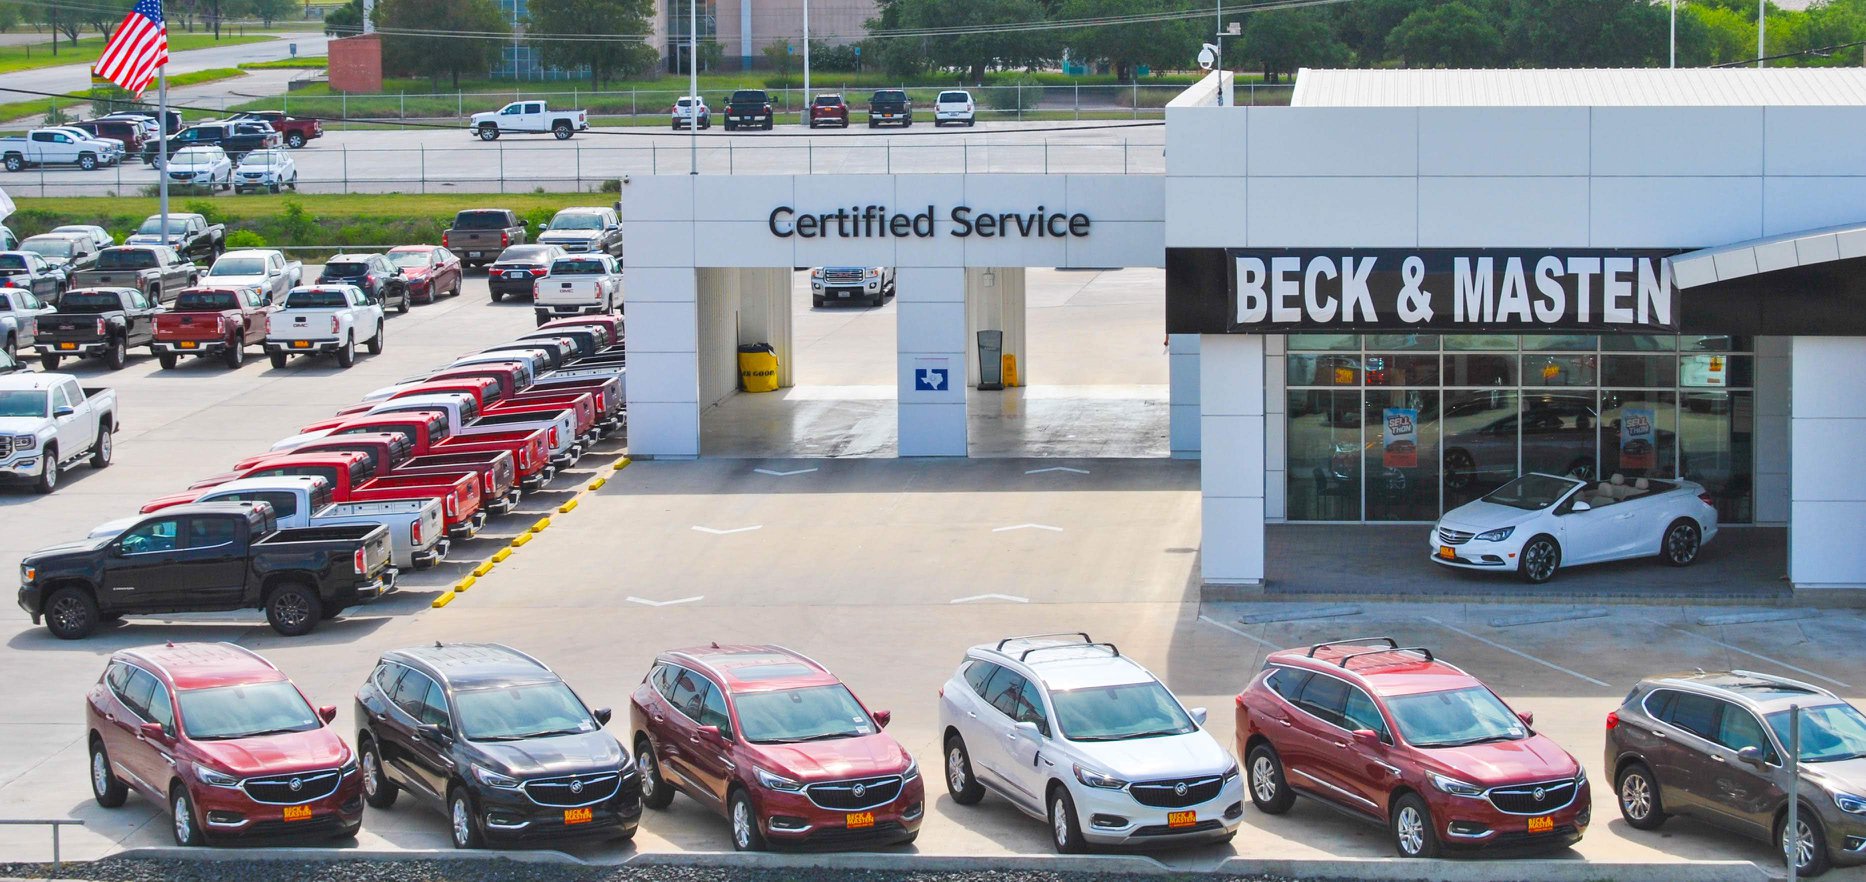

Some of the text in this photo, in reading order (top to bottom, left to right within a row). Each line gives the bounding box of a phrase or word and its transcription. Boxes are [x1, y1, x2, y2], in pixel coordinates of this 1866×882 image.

[769, 205, 1090, 238] Certified Service
[1236, 256, 1672, 325] BECK & MASTEN
[1389, 417, 1410, 427] SELL
[1391, 424, 1412, 434] THON
